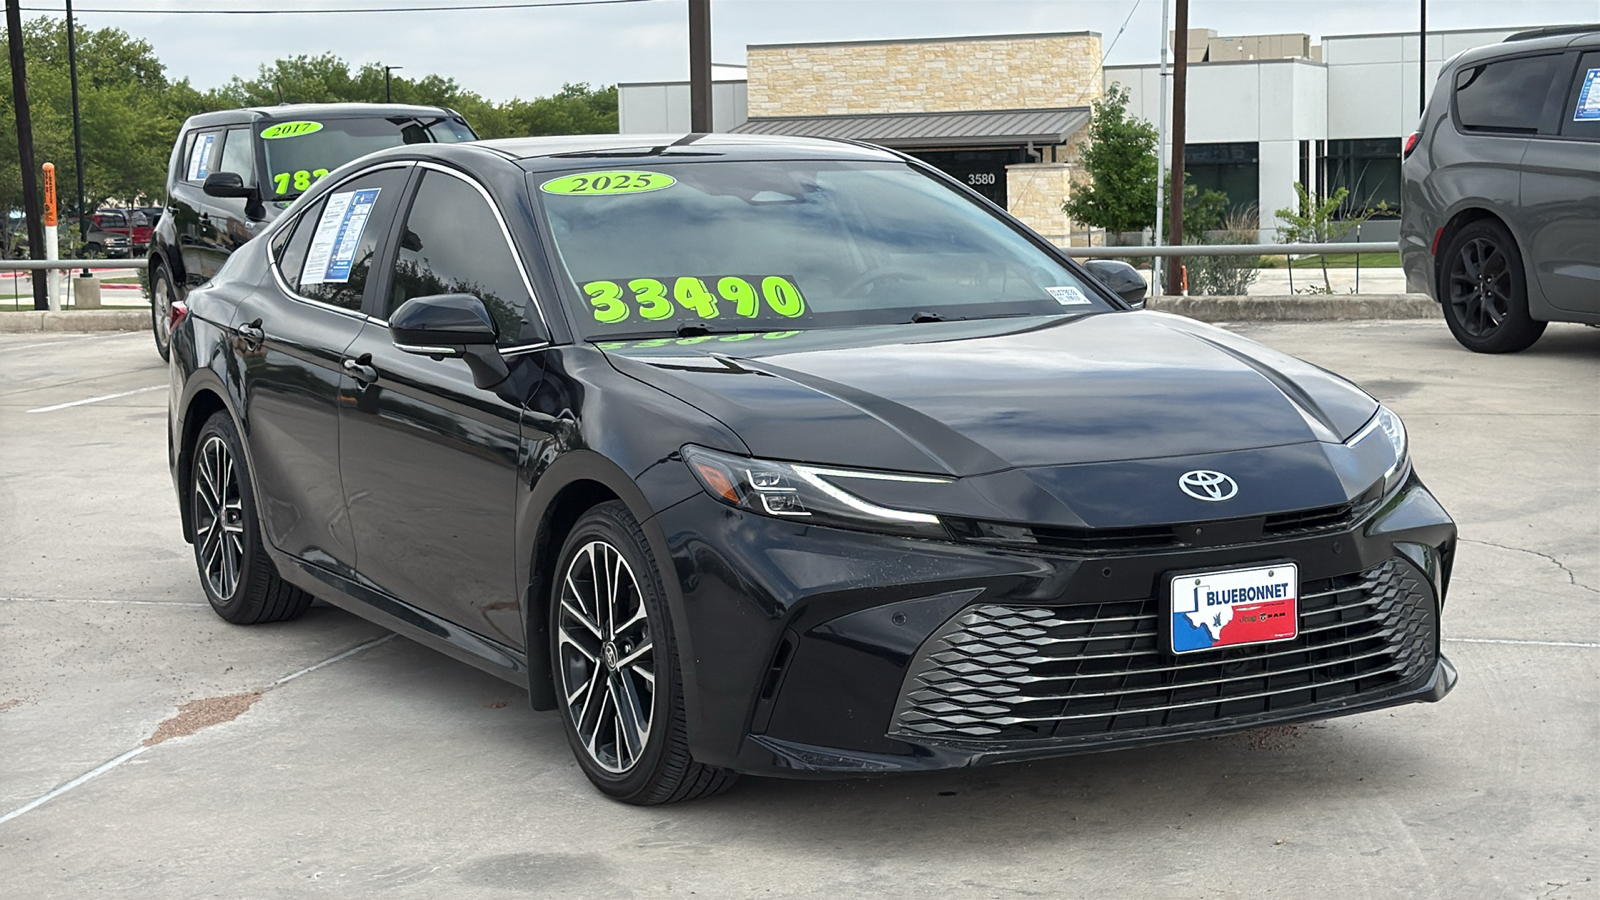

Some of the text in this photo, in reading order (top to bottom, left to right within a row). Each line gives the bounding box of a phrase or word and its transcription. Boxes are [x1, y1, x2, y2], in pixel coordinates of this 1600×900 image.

[272, 123, 311, 137] 2017
[569, 174, 653, 193] 2025
[968, 173, 996, 185] 3580
[583, 276, 805, 324] 33490
[1206, 582, 1289, 606] BLUEBONNET
